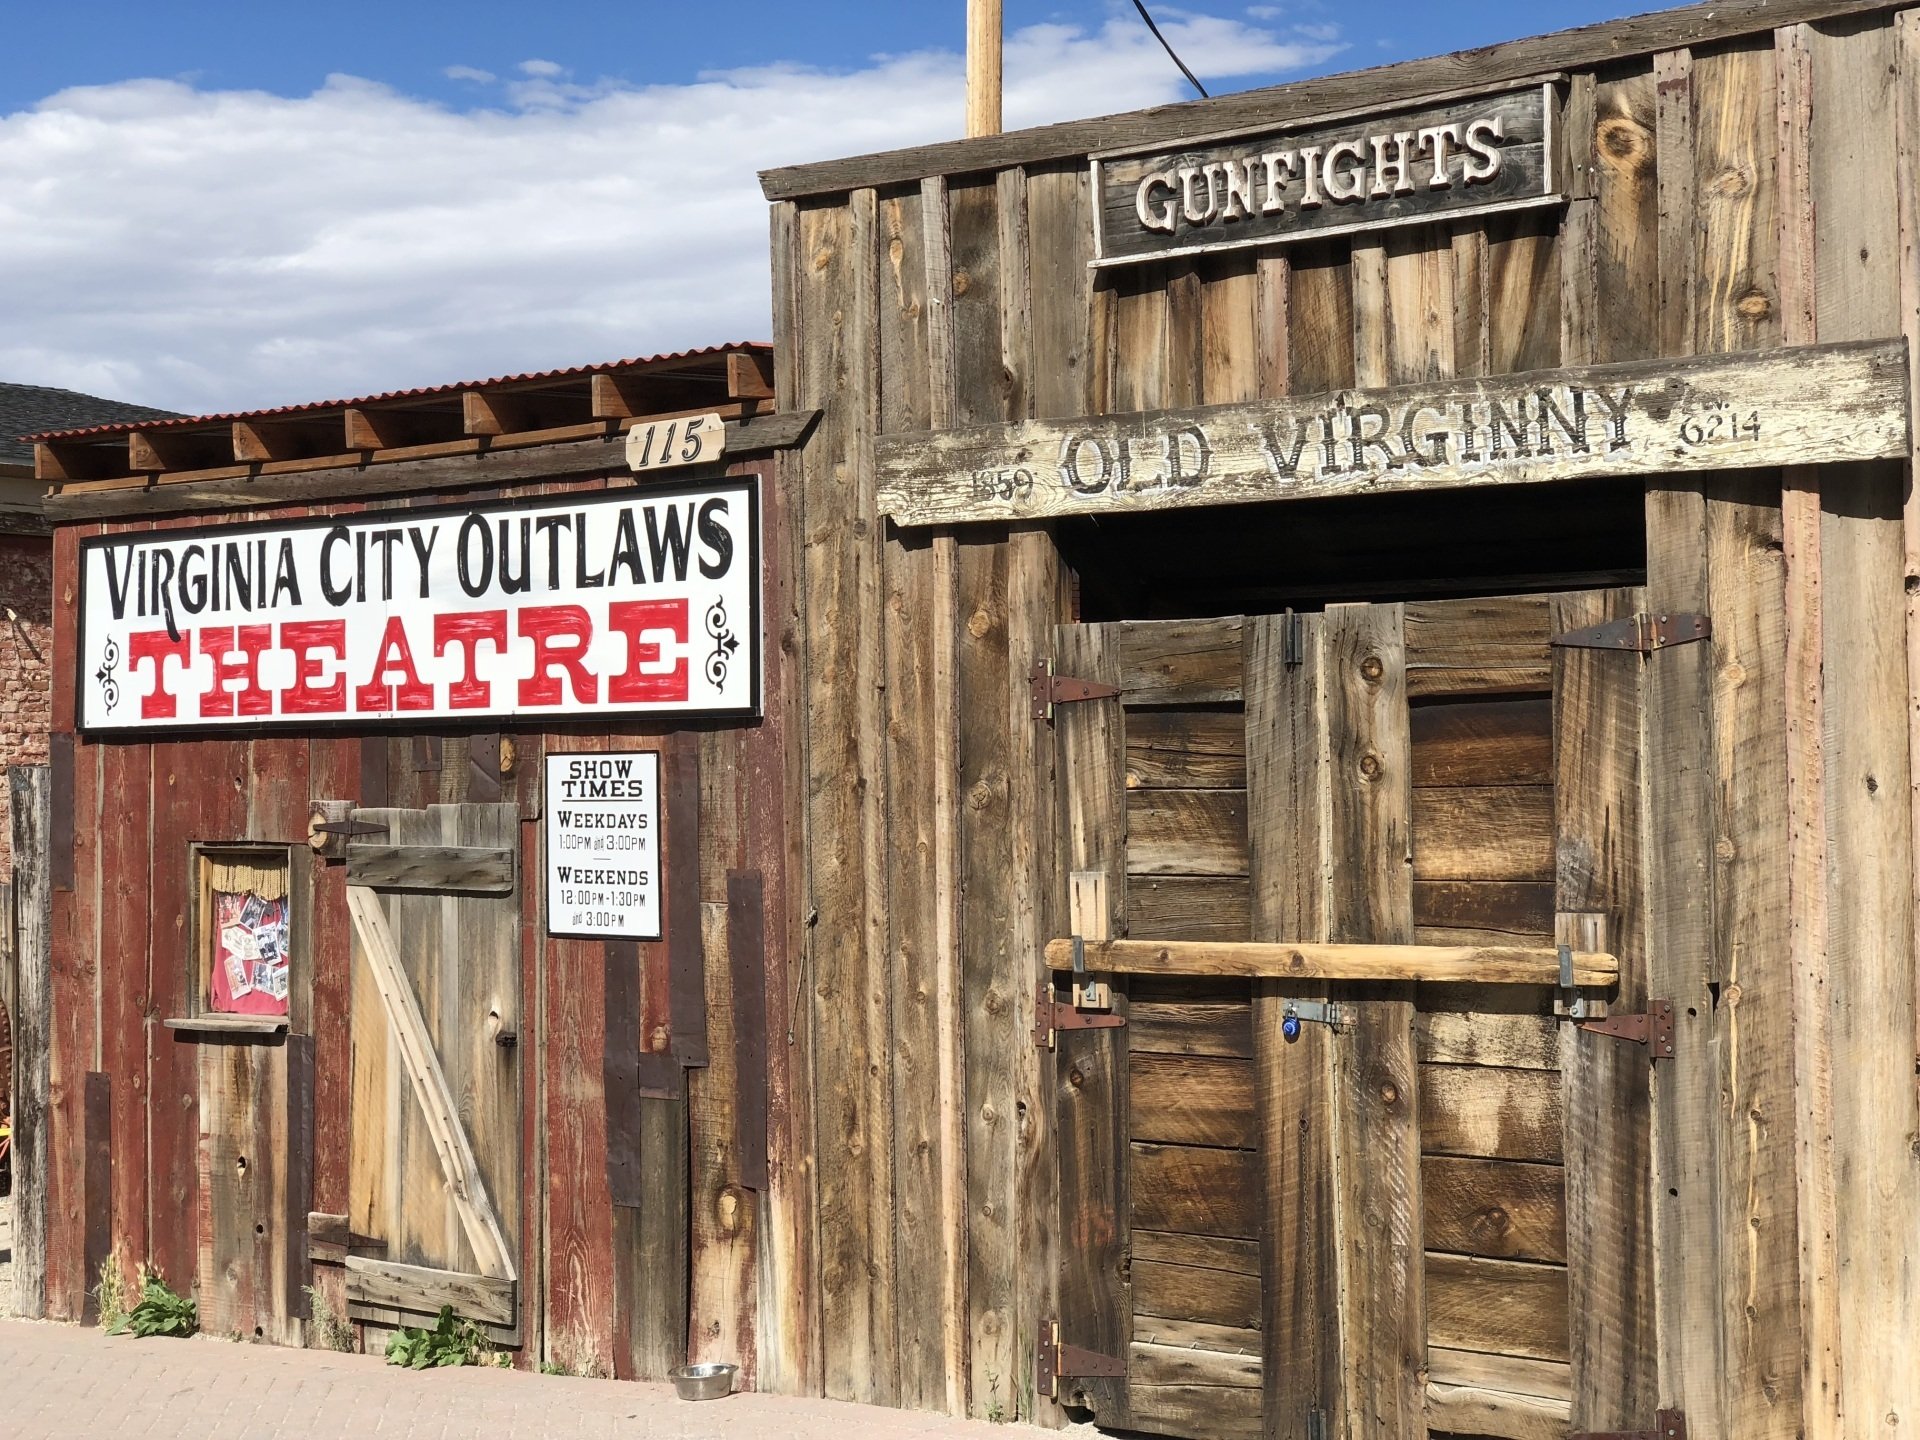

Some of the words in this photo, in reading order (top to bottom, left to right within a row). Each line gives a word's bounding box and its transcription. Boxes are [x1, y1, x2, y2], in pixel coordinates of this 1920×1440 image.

[1135, 115, 1504, 236] GUNFIGHTS
[639, 418, 704, 467] 115
[1680, 411, 1761, 447] 6214
[973, 467, 1034, 503] 1859
[1062, 424, 1212, 498] OLD
[1260, 386, 1634, 484] VIRGINNY
[103, 535, 303, 643] VIRGINIA
[320, 523, 438, 608] CITY
[458, 497, 734, 598] OUTLAWS
[128, 598, 690, 719] THEATRE
[569, 760, 633, 779] SHOW
[561, 780, 643, 797] TIMES
[557, 810, 648, 829] WEEKDAYS
[559, 834, 592, 850] 1:00PM
[606, 835, 646, 851] 3:00PM
[557, 866, 649, 886] WEEKENDS
[586, 911, 625, 928] 3:00PM
